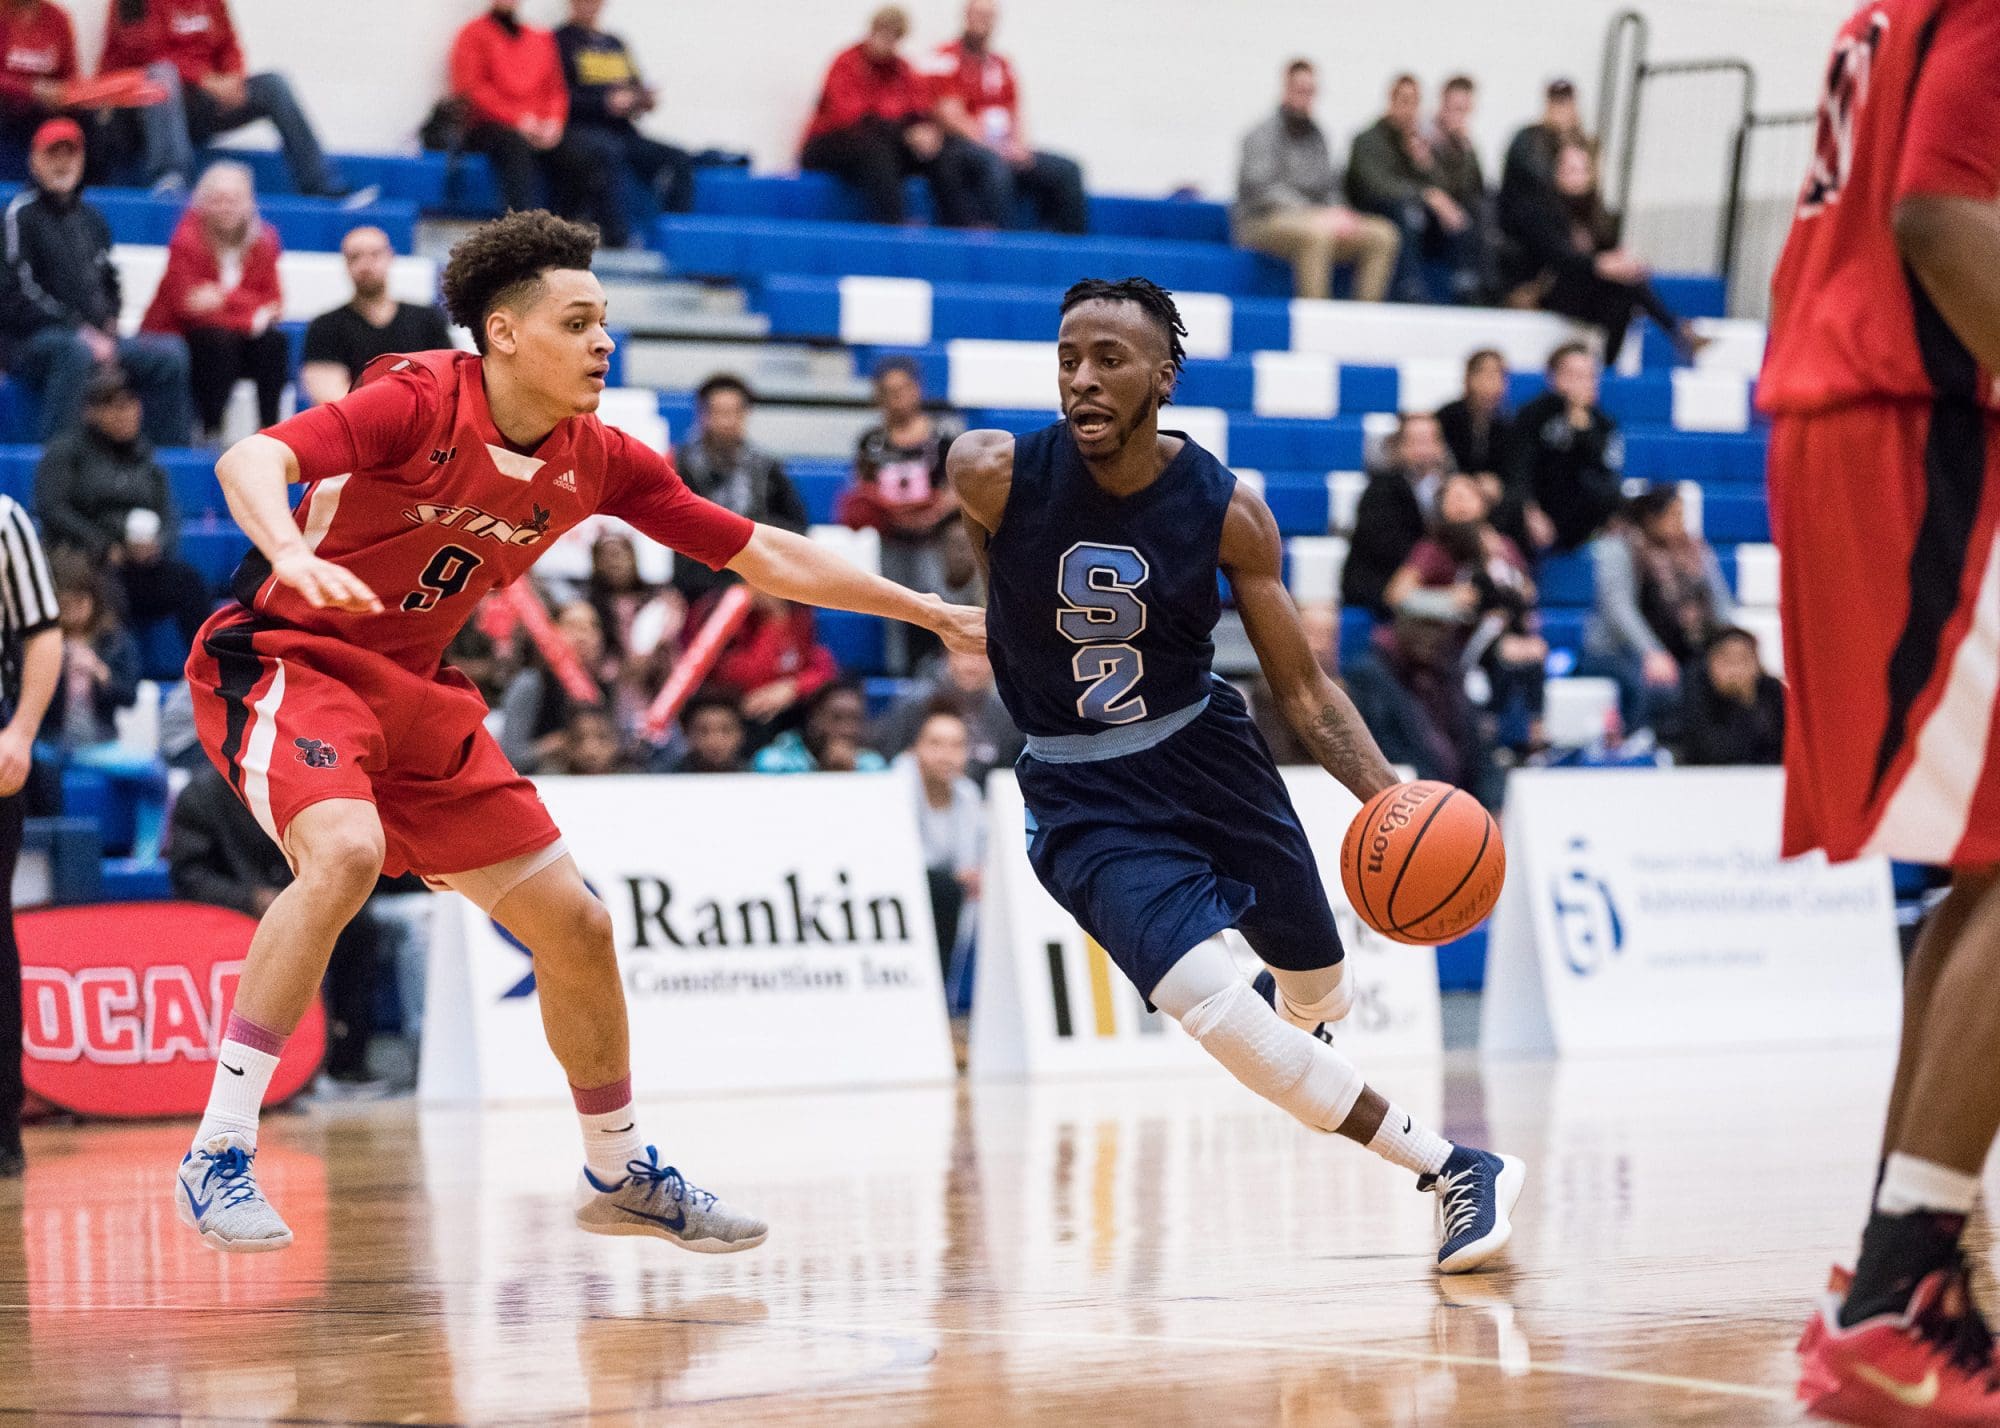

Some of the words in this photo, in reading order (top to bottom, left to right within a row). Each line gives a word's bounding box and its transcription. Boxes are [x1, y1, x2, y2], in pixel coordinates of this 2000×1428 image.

[552, 479, 577, 493] adidas
[400, 544, 484, 613] 9
[1057, 541, 1150, 644] S
[1072, 643, 1148, 725] 2
[1367, 784, 1438, 874] Wilson
[622, 871, 910, 948] Rankin
[626, 958, 846, 994] Construction
